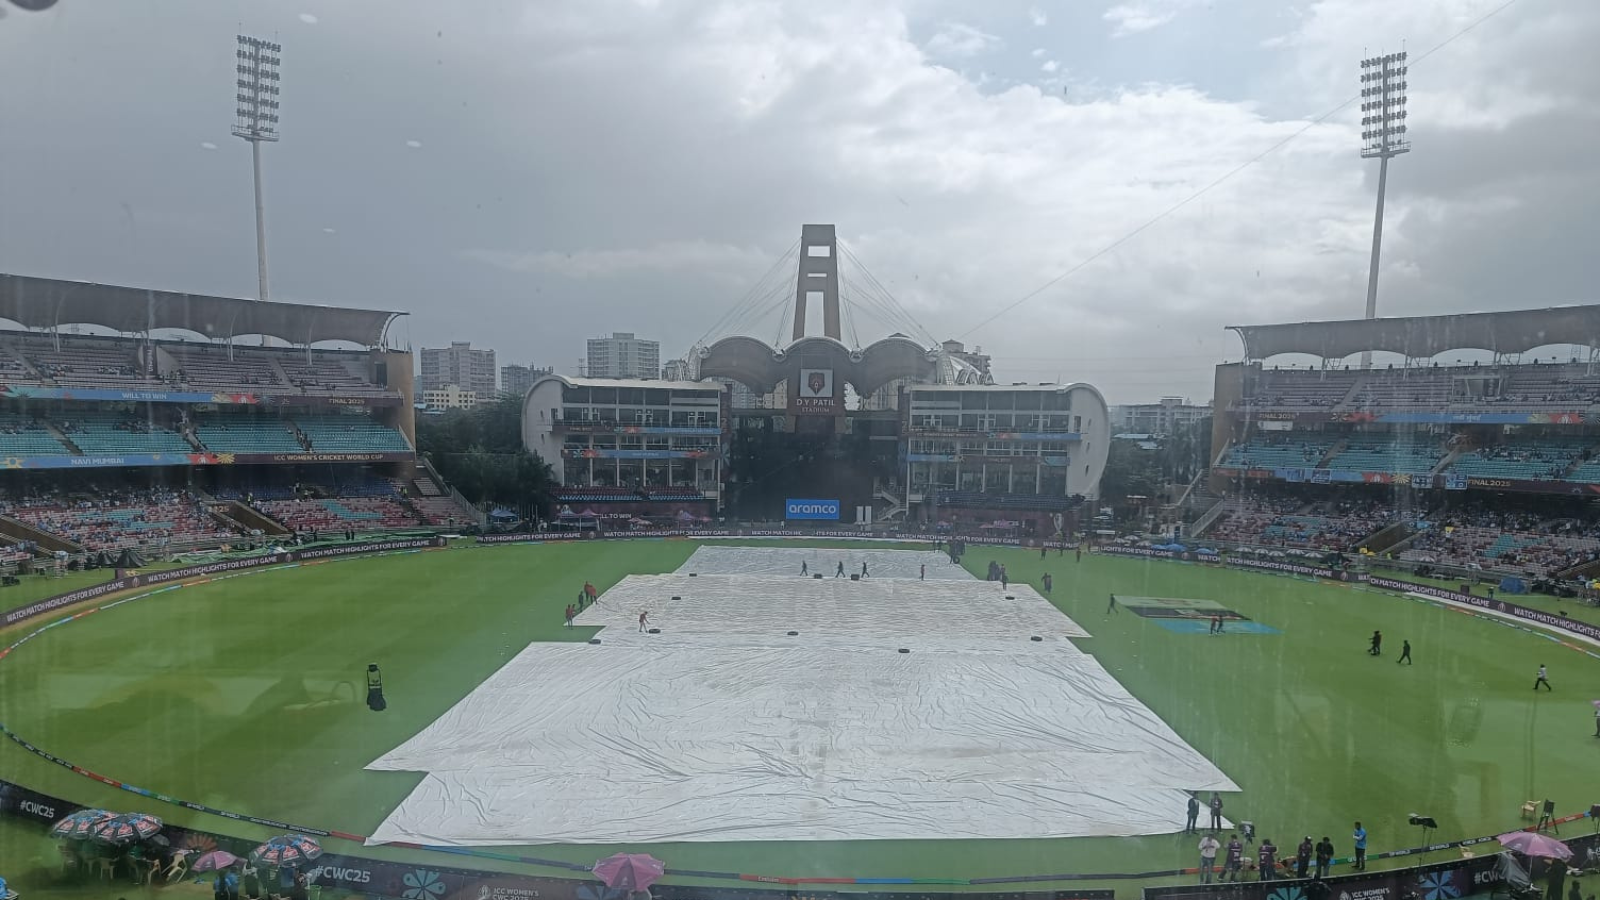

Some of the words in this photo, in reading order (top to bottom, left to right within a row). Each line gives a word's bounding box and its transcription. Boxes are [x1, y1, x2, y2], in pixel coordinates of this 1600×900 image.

[789, 504, 836, 514] aramco
[345, 545, 379, 554] HIGHLIGHTS
[148, 572, 170, 583] WATCH
[170, 568, 191, 579] MATCH
[192, 563, 227, 575] HIGHLIGHTS
[240, 558, 259, 567] EVERY
[260, 556, 277, 564] GAME
[1244, 559, 1279, 569] HIGHLIGHTS
[1293, 564, 1313, 573] EVERY
[1314, 568, 1333, 577] GAME
[7, 611, 27, 623] WATCH
[26, 604, 45, 616] MATCH
[45, 595, 76, 610] HIGHLIGHTS
[76, 591, 88, 600] FOR
[89, 586, 106, 597] EVERY
[106, 581, 124, 592] GAME
[1380, 579, 1401, 588] MATCH
[1401, 582, 1437, 596] HIGHLIGHTS
[1437, 590, 1450, 599] FOR
[1450, 592, 1470, 603] EVERY
[1471, 597, 1490, 607] GAME
[1514, 607, 1536, 620] WATCH
[1537, 613, 1558, 625] MATCH
[1559, 619, 1595, 636] HIGHLIGHTS
[20, 800, 55, 818] #CWC25
[316, 865, 371, 883] #CWC25
[507, 888, 539, 897] WOMEN'S
[1362, 887, 1390, 896] WOMEN'S
